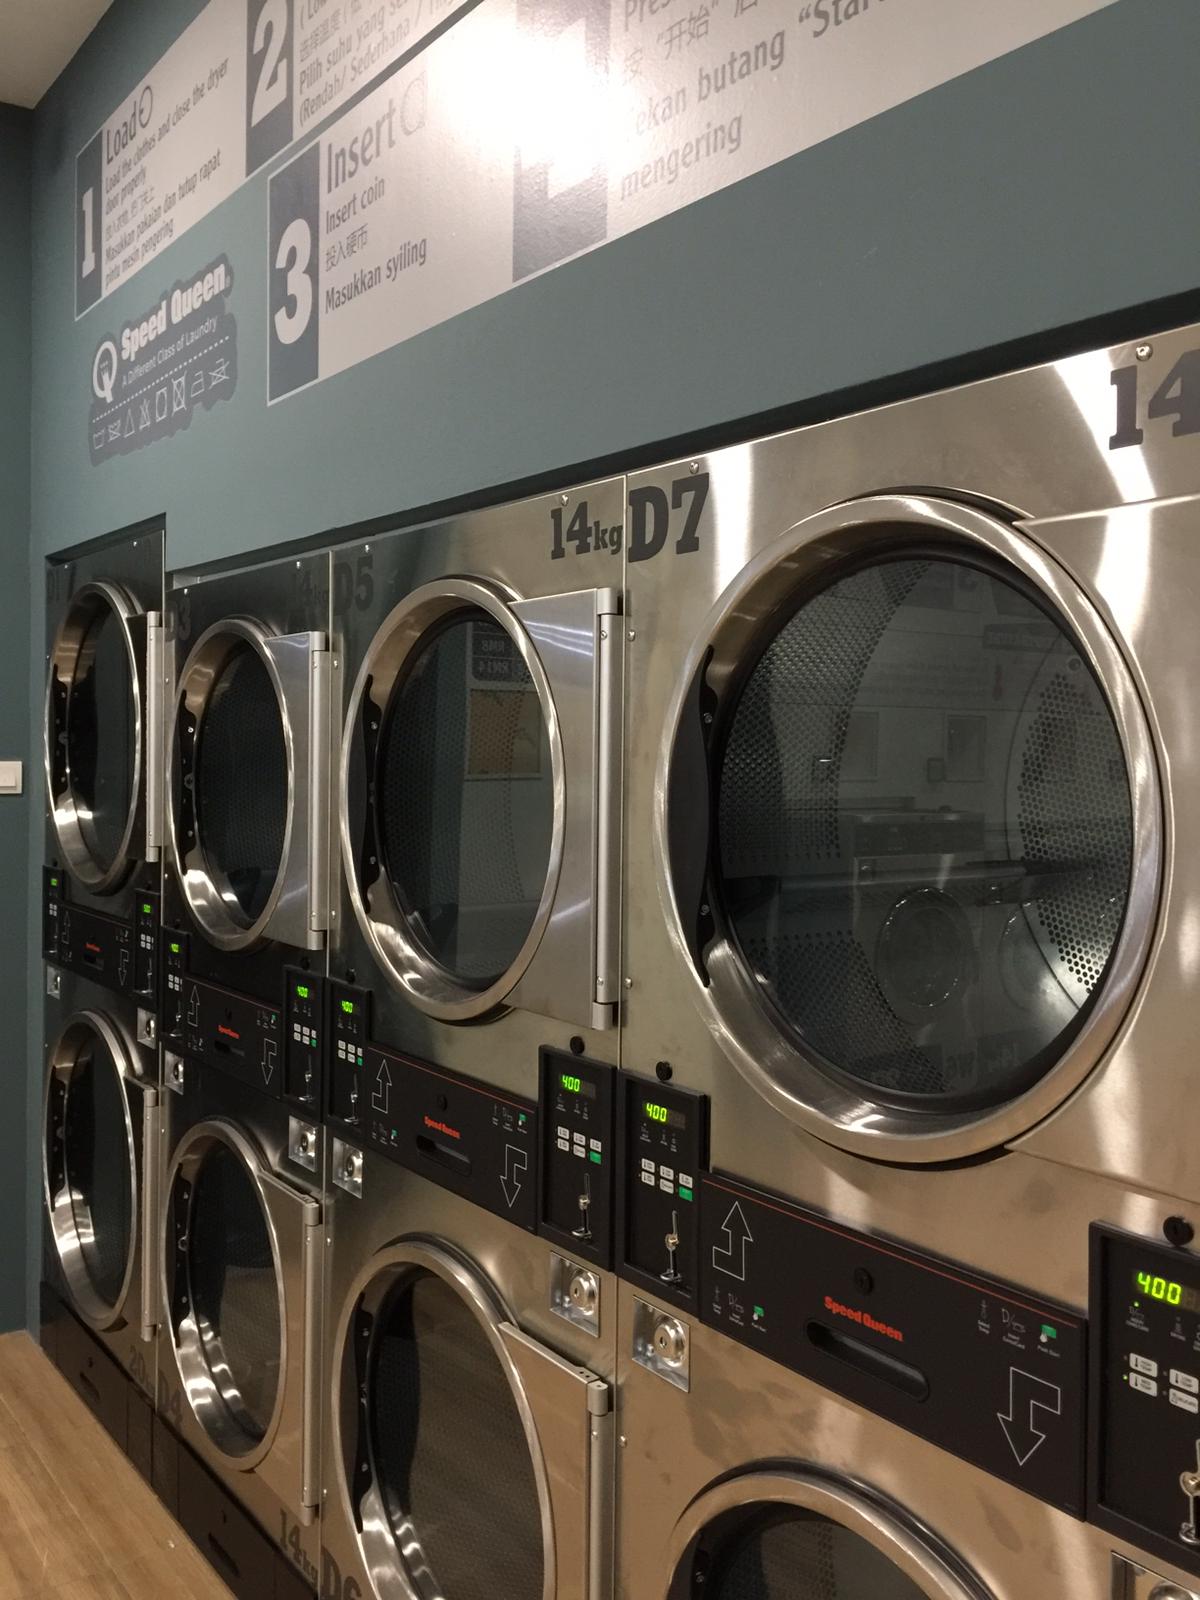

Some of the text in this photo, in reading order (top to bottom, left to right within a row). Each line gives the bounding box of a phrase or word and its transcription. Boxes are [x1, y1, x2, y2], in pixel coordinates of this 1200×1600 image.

[250, 0, 288, 128] 2
[299, 56, 322, 95] Pilih
[326, 32, 352, 73] suhu
[356, 6, 385, 52] yang
[351, 17, 410, 82] Sederhana
[628, 86, 687, 140] ekan
[697, 30, 786, 103] butang
[106, 100, 137, 165] Load
[133, 133, 156, 166] clothes
[157, 112, 171, 142] and
[172, 97, 191, 126] close
[192, 82, 205, 106] the
[207, 57, 229, 91] dryer
[327, 98, 397, 195] Insert
[620, 113, 743, 200] mengering
[82, 187, 96, 279] 1
[105, 229, 136, 265] Masukkan
[136, 205, 162, 242] pakaian
[162, 191, 177, 215] dan
[177, 173, 198, 201] tutup
[199, 148, 221, 183] rapat
[141, 218, 174, 262] pengering
[326, 176, 385, 235] Insert coin
[274, 218, 312, 345] 3
[325, 223, 369, 273] 投入硬币
[325, 238, 428, 315] Masukkan syiling
[121, 264, 226, 362] Speed Queen
[128, 356, 156, 384] Different
[157, 344, 176, 364] Class
[176, 337, 185, 351] of
[185, 316, 217, 346] Laundry
[550, 501, 624, 560] 14kg
[627, 472, 710, 563] D7
[333, 554, 374, 615] D5
[562, 1074, 581, 1093] 400
[646, 1102, 668, 1122] 400
[824, 1295, 904, 1342] Speed Queen
[1137, 1271, 1182, 1305] 400
